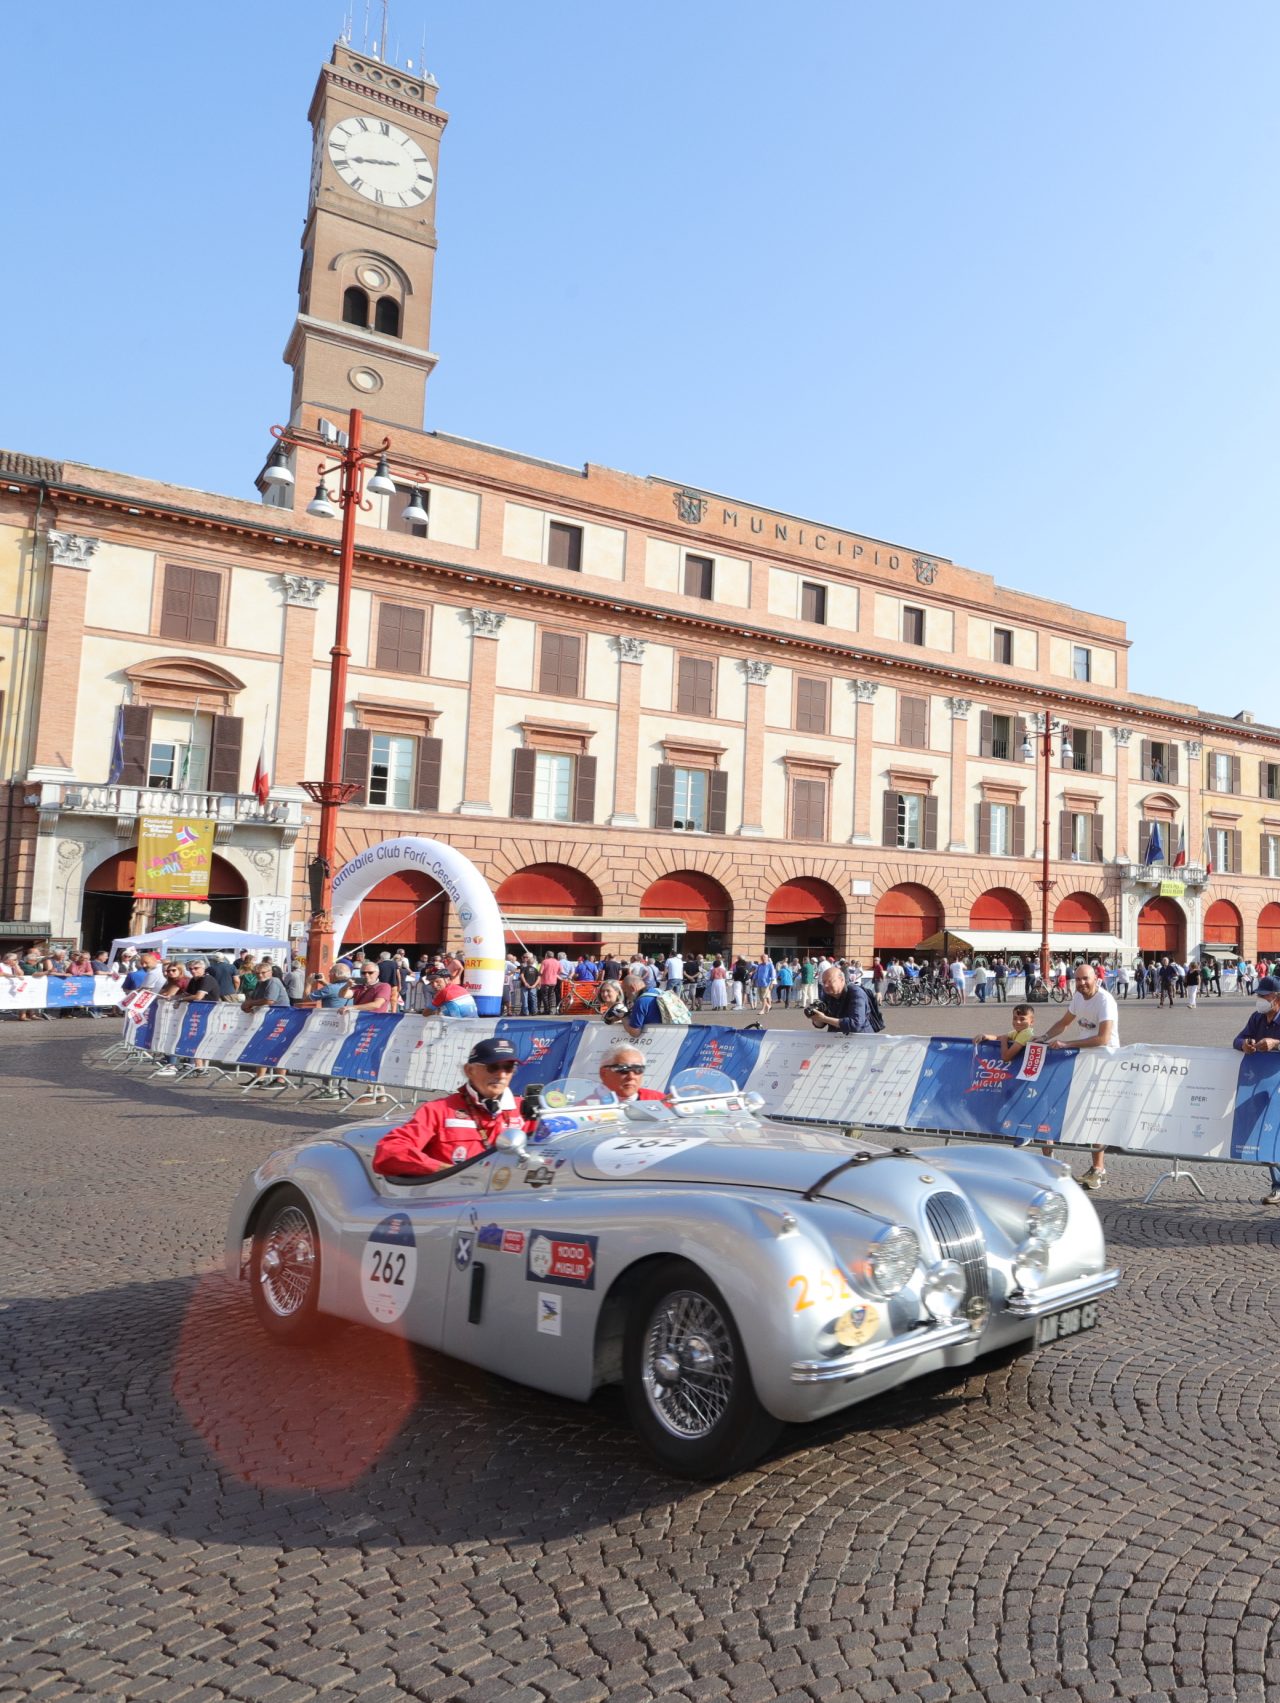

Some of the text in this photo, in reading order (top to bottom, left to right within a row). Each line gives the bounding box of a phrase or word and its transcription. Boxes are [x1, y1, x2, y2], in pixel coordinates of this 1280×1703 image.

[723, 508, 901, 570] MUNICIPIO
[332, 851, 375, 892] tomobile
[376, 845, 400, 860] Club
[432, 861, 461, 903] Cesena
[978, 1059, 1012, 1071] 2022
[1120, 1061, 1189, 1076] CHOPARD
[975, 1071, 1006, 1080] 1000
[971, 1080, 1003, 1089] MIGLIA
[614, 1137, 688, 1150] 262
[557, 1246, 585, 1260] 1000
[370, 1250, 407, 1286] 262
[554, 1262, 585, 1277] MIGLIA
